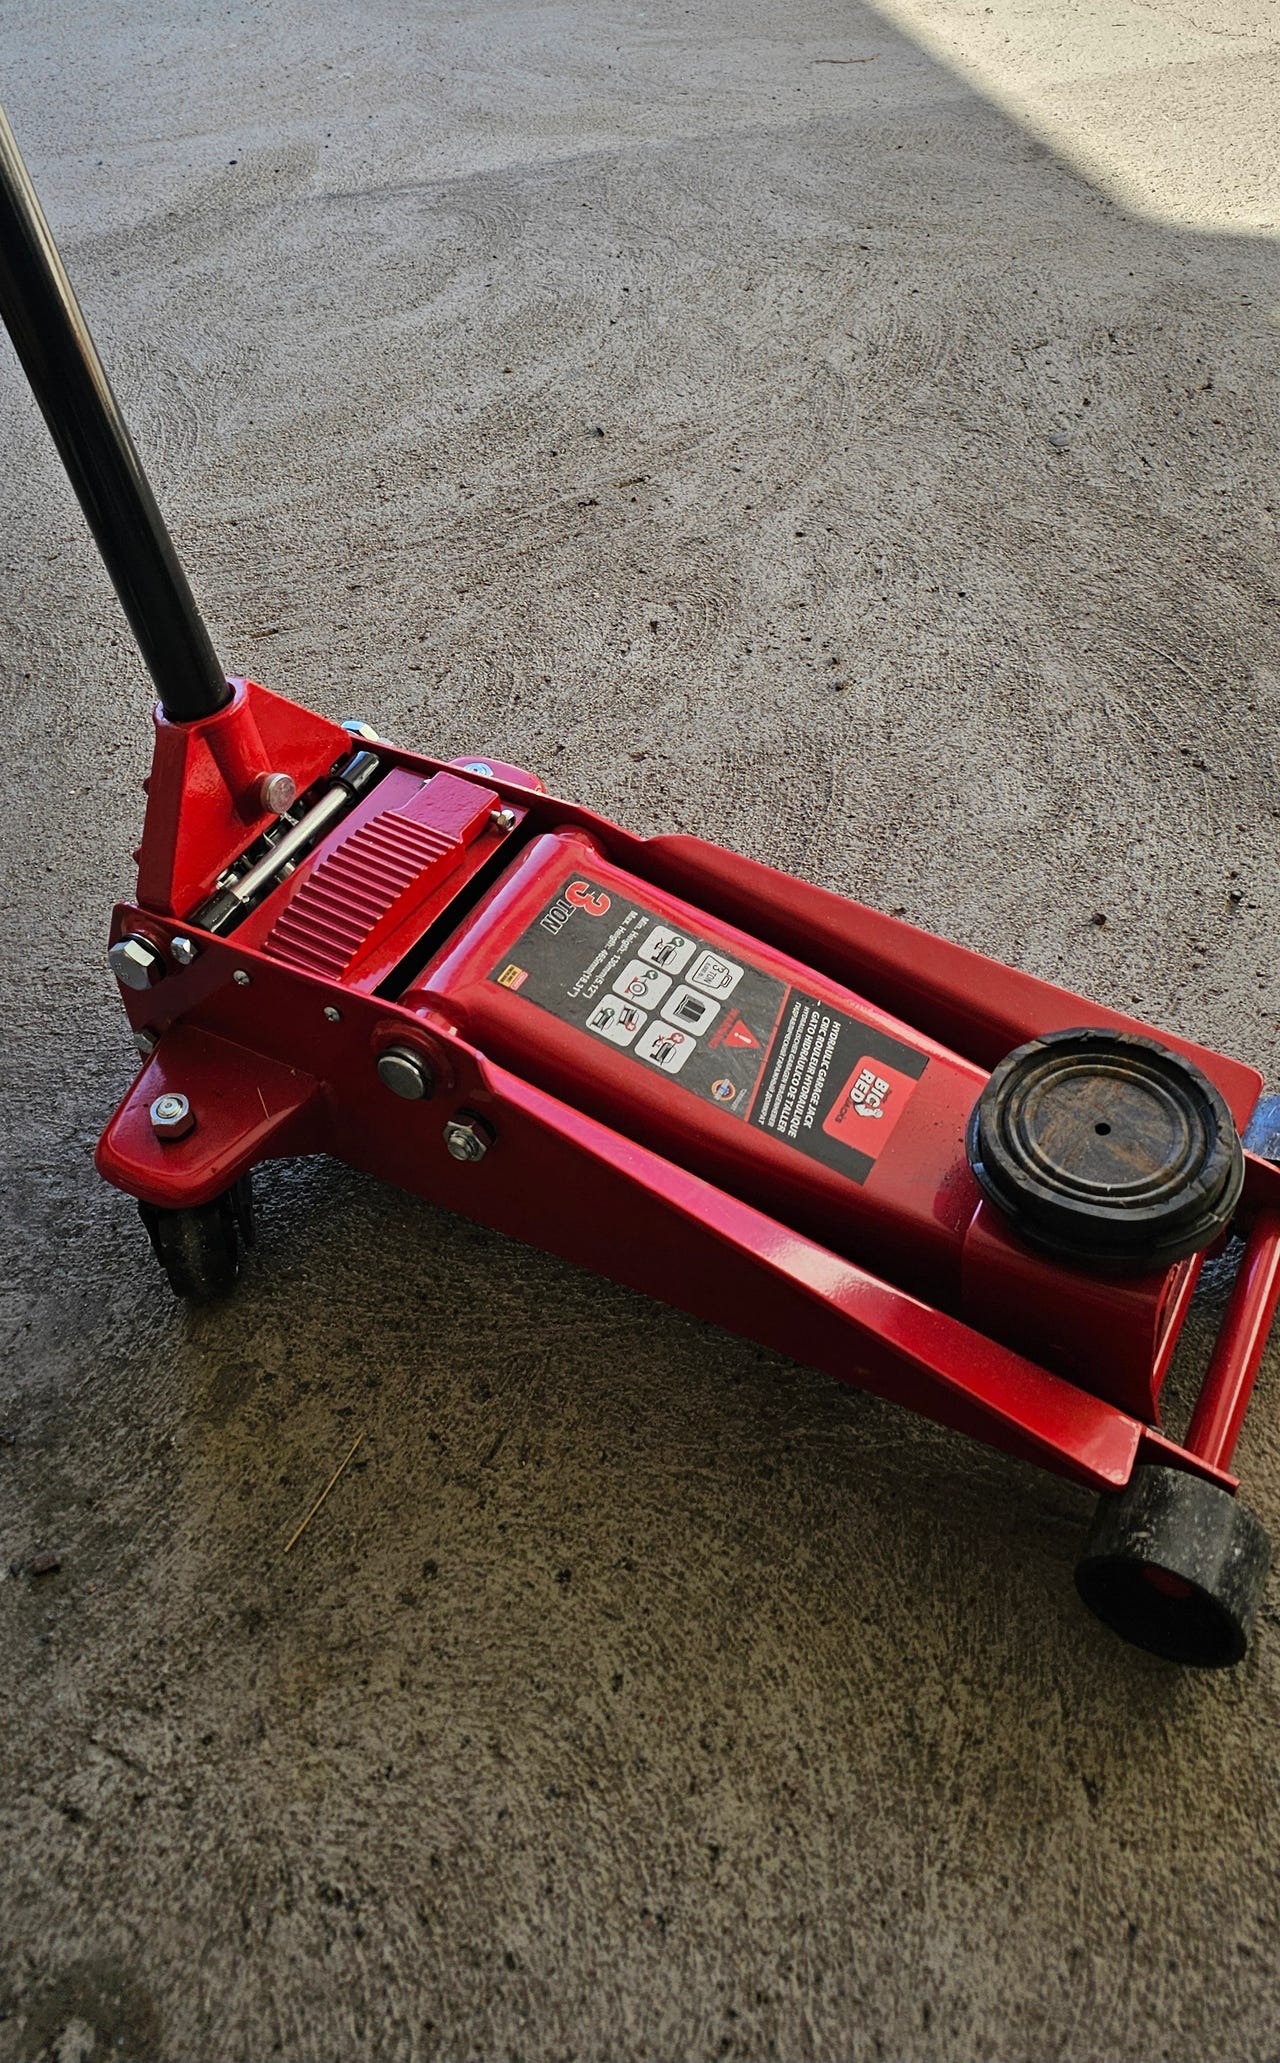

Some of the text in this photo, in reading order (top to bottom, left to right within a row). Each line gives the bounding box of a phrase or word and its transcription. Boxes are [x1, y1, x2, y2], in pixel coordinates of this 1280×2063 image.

[539, 882, 610, 935] 3 TON
[621, 910, 638, 925] Max.
[634, 916, 649, 929] Min.
[703, 963, 725, 983] 3 TON
[768, 1006, 810, 1127] HYDRAULISCHER GARAGEN WAGENHEBER
[776, 1011, 820, 1132] GATO HIDRÁULICO DE TALLER
[787, 1016, 830, 1138] CRIC ROULEUR HYDRAULIQUE
[803, 1021, 841, 1128] HYDRAULIC GARAGE JACK
[850, 1068, 875, 1106] RED
[865, 1077, 889, 1110] BIG
